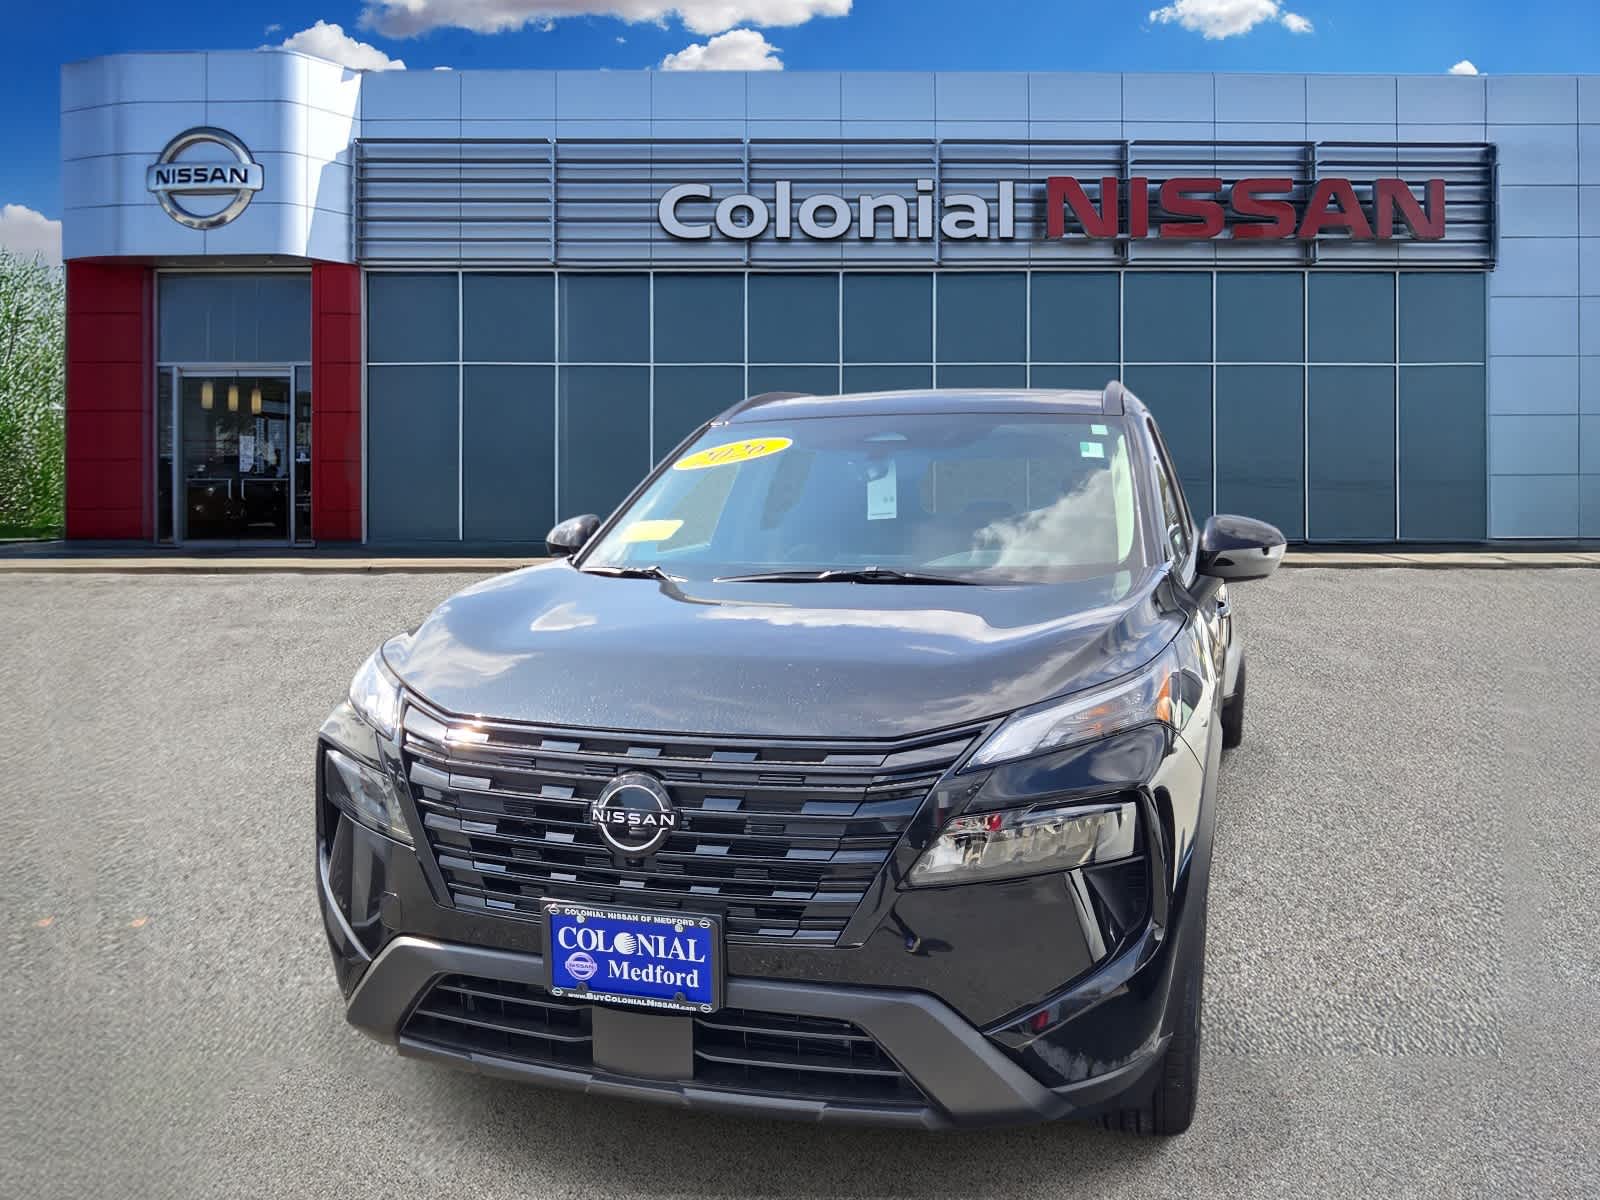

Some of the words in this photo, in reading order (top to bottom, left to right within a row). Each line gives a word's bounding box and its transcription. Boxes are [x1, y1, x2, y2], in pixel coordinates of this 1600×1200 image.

[156, 168, 248, 185] NISSAN
[658, 179, 1015, 241] Colonial
[1046, 176, 1446, 240] NISSAN
[592, 809, 675, 826] NISSAN
[564, 908, 606, 919] COLONIAL
[607, 913, 639, 923] NISSAN
[640, 915, 652, 923] OF
[653, 917, 695, 928] MEDFORD
[558, 926, 706, 963] COLONIAL
[607, 959, 700, 988] Medford
